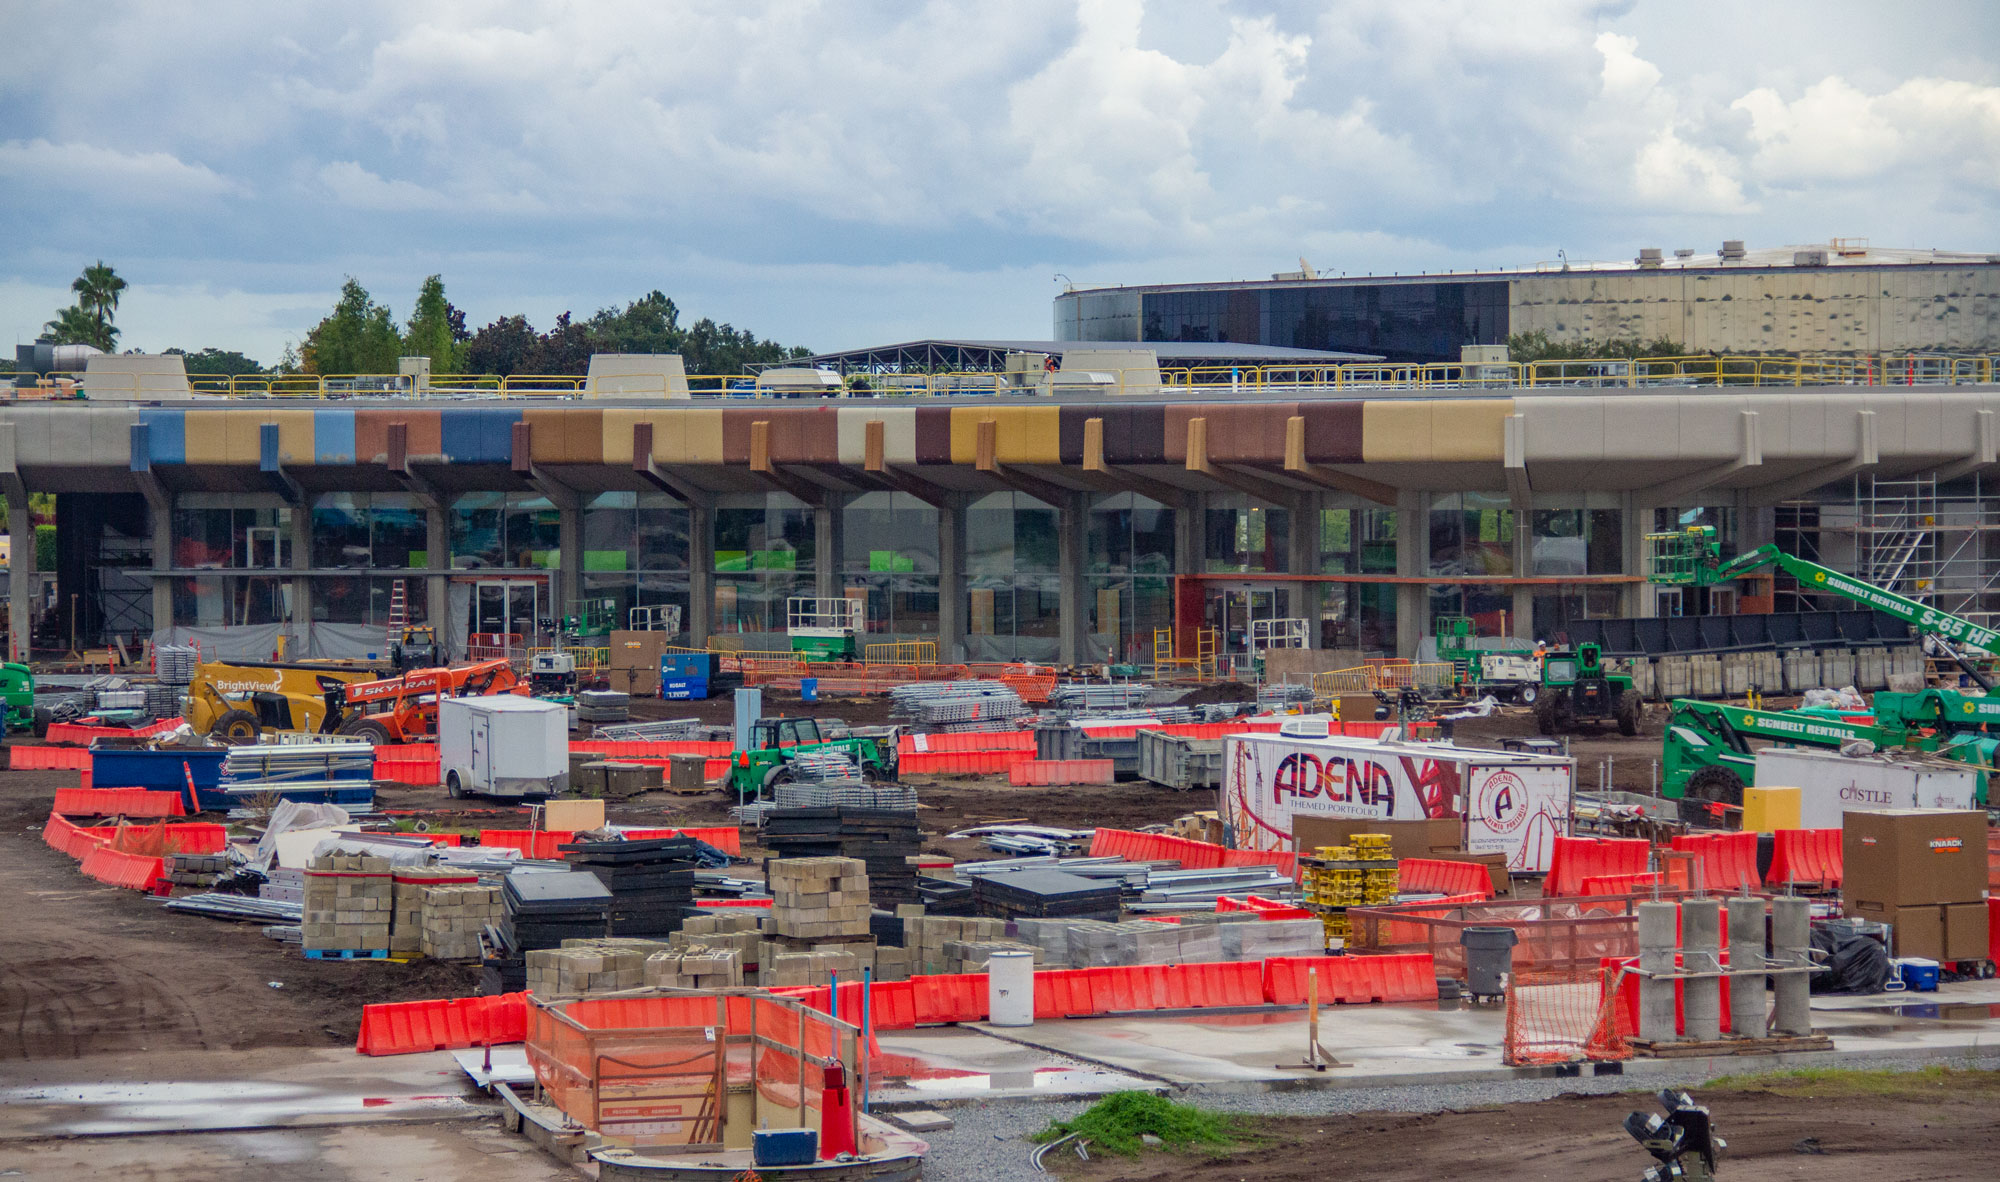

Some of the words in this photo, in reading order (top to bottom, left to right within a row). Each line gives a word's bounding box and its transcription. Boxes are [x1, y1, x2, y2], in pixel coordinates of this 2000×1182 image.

[1827, 577, 1871, 599] SUNBELT
[1870, 593, 1914, 616] RENTALS
[1919, 610, 1966, 636] S-65
[1966, 627, 1996, 647] HF
[217, 680, 275, 692] BrightView
[1757, 717, 1806, 733] SUNBELT
[1806, 724, 1856, 740] RENTALS
[1273, 752, 1395, 817] ADENA
[1488, 774, 1513, 790] ADENA
[1290, 800, 1326, 811] THEMED
[1327, 804, 1378, 817] PORTFOLIO
[1494, 785, 1513, 820] A
[1929, 839, 1963, 849] KNAACK
